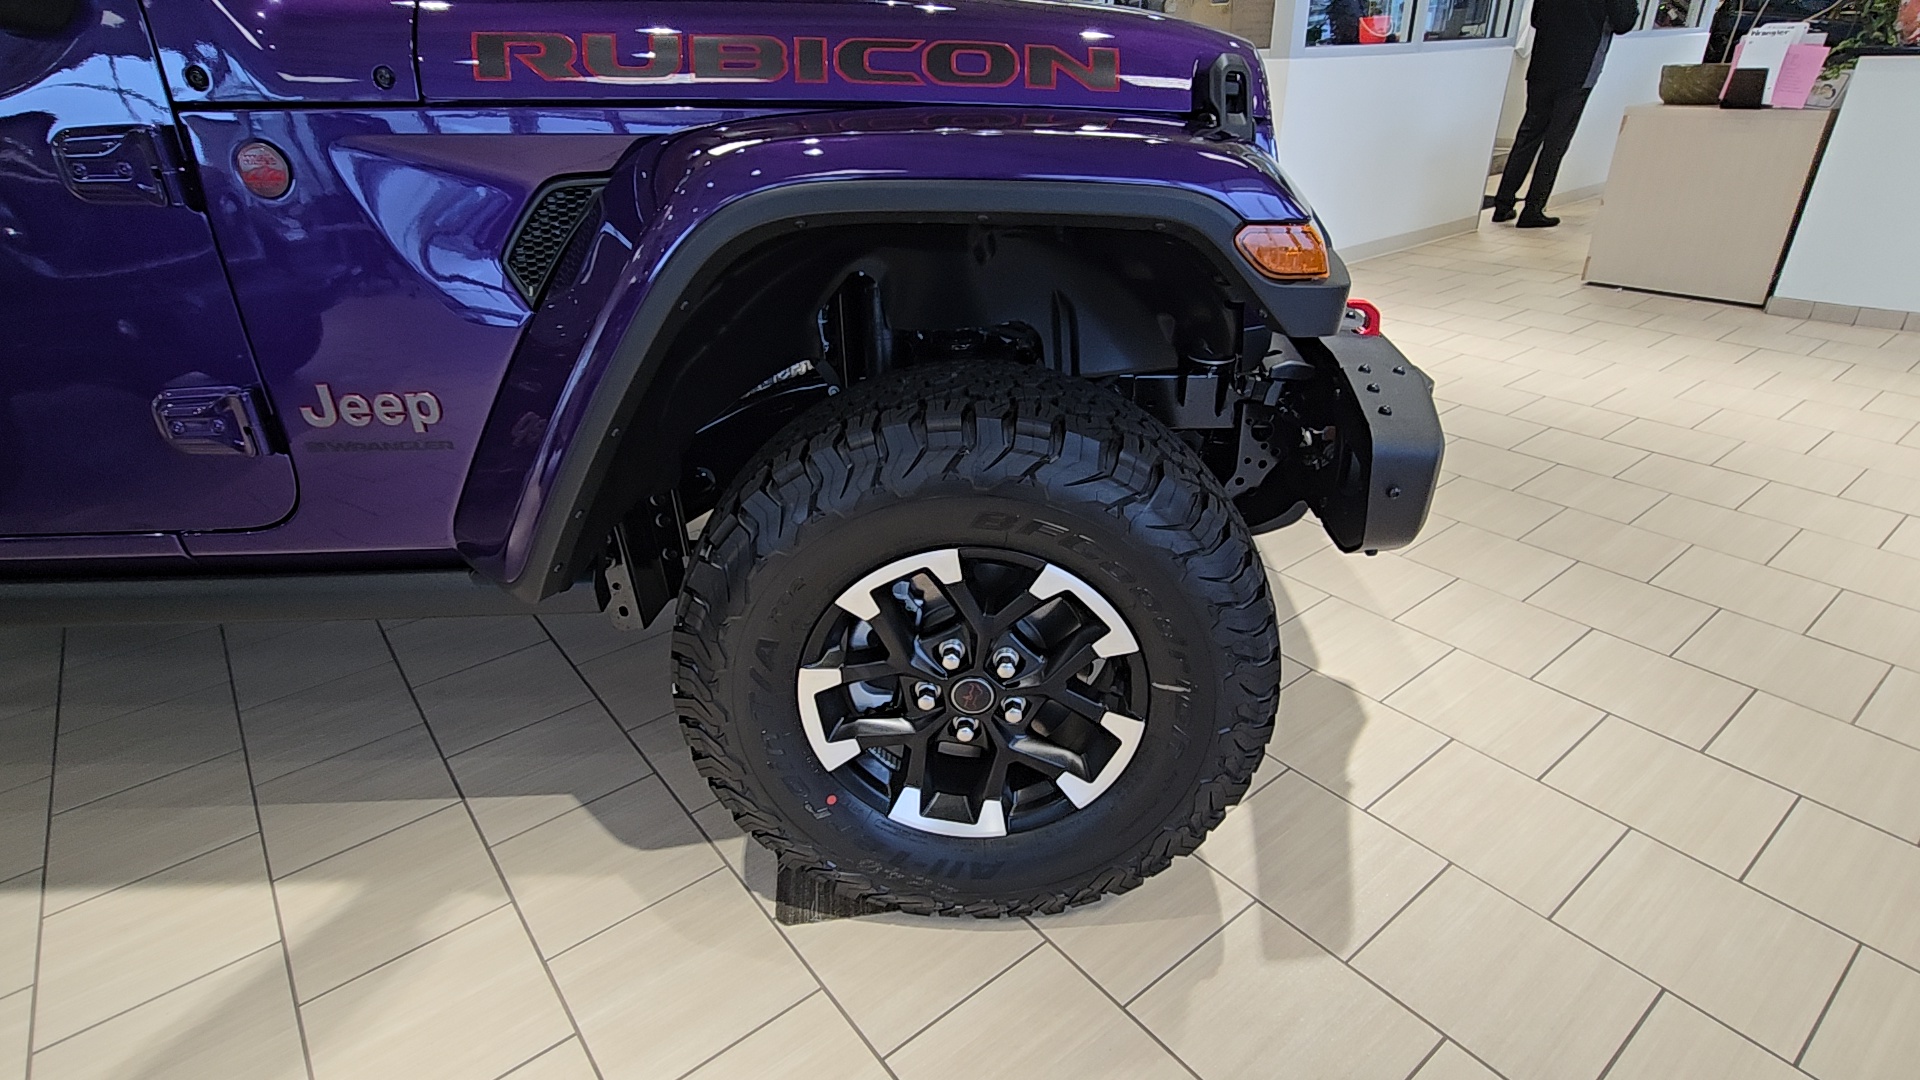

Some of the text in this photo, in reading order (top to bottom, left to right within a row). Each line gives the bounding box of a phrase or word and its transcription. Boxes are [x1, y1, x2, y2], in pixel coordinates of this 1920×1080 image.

[471, 31, 1120, 92] RUBICON
[299, 382, 443, 433] Jeep
[326, 441, 455, 452] WRANGLER
